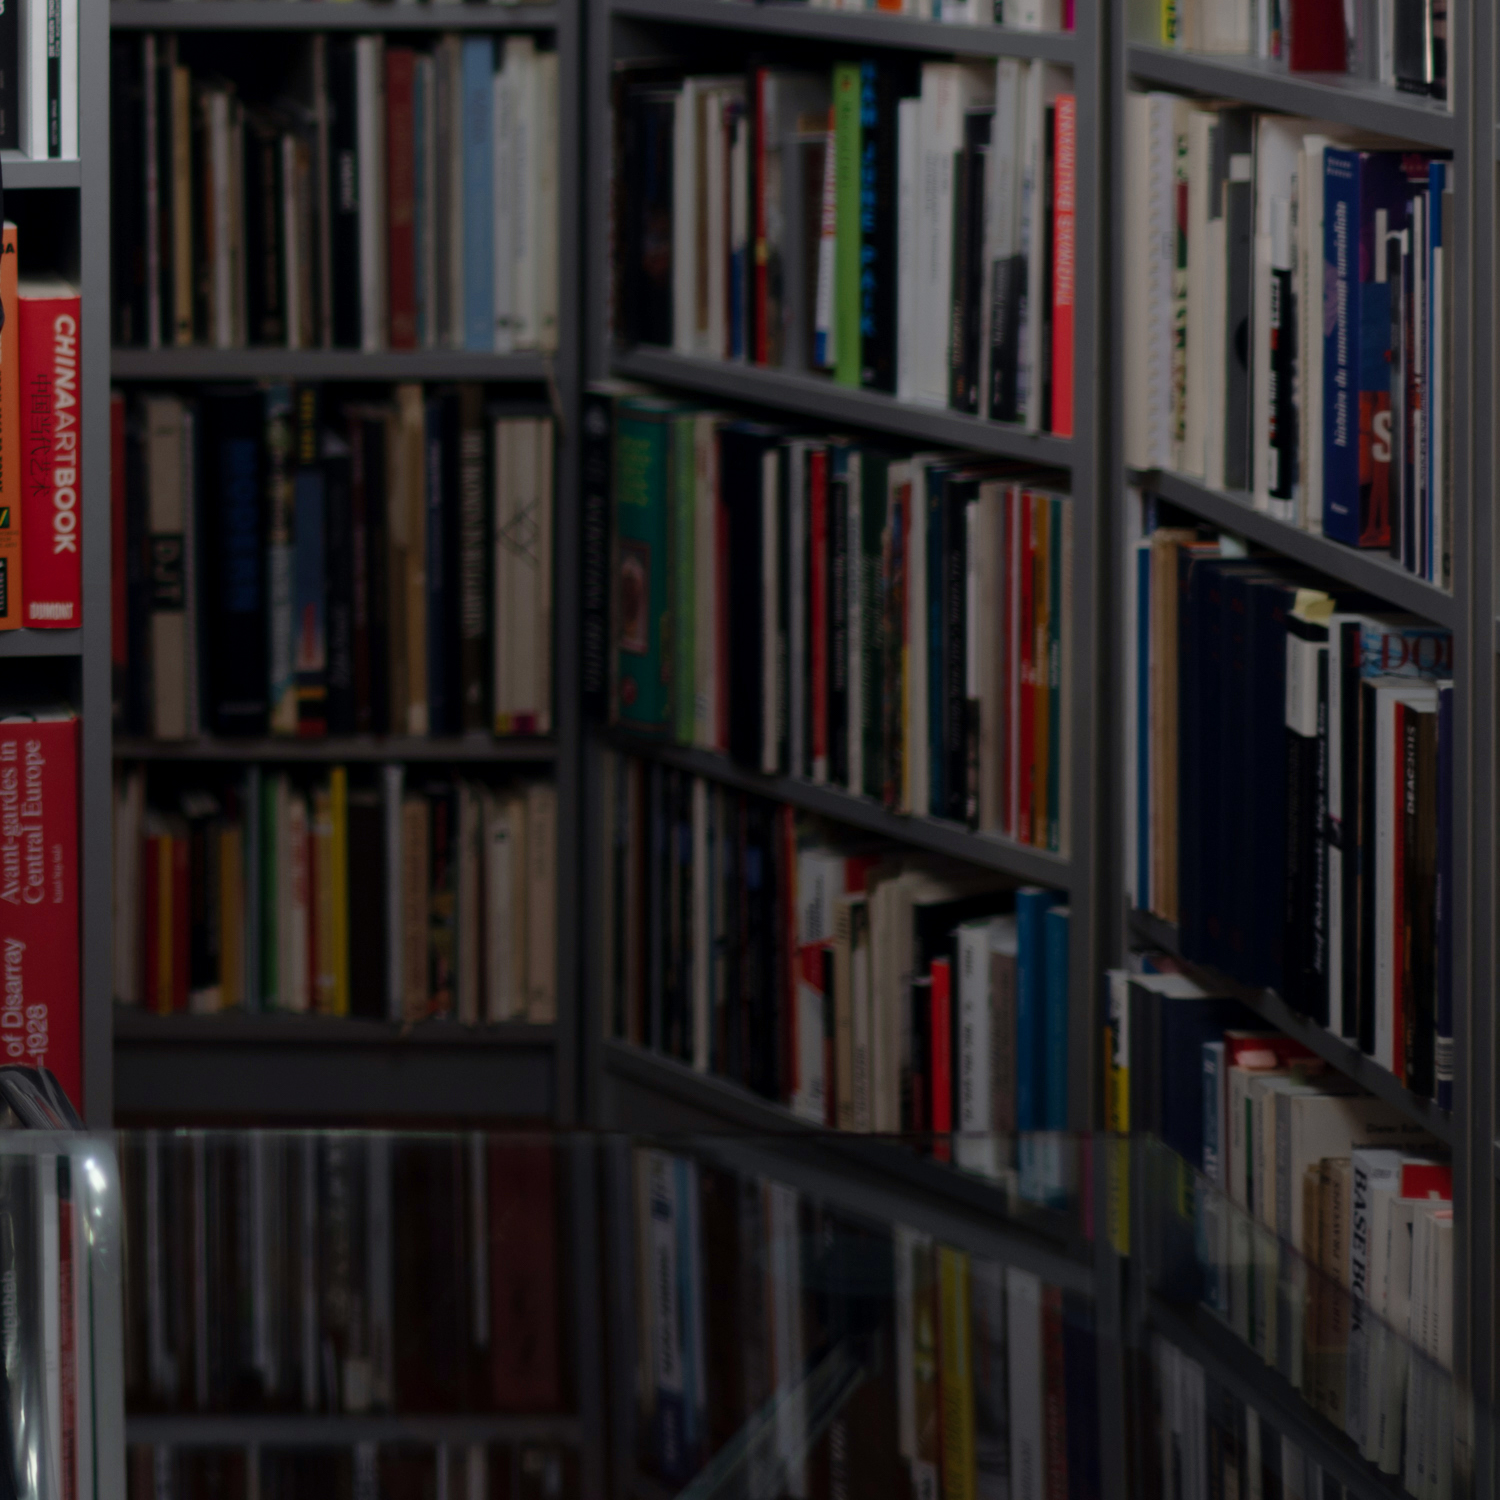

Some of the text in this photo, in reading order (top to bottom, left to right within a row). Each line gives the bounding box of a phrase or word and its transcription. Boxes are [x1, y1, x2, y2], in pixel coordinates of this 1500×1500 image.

[1333, 391, 1349, 446] histoire
[1334, 369, 1348, 387] du
[29, 373, 53, 497] 中国当代艺术
[20, 739, 46, 904] Central Europe
[0, 938, 26, 1057] of Disarray
[1352, 1167, 1369, 1258] BASE
